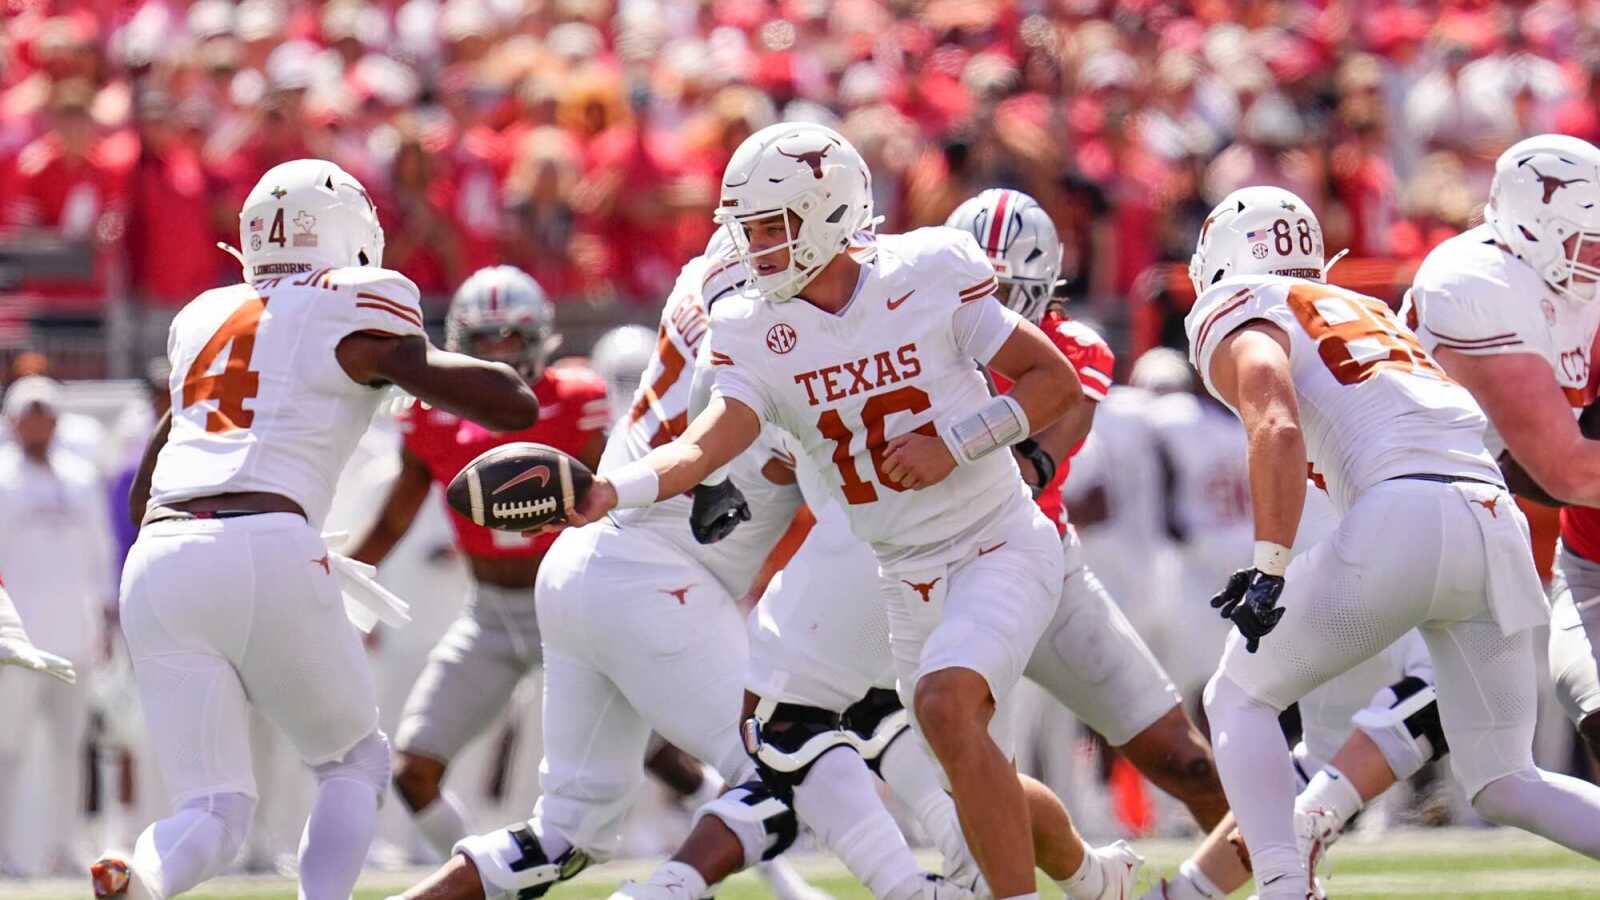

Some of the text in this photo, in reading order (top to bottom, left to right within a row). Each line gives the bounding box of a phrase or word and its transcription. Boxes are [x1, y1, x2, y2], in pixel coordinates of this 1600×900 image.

[268, 208, 287, 248] 4
[1273, 218, 1312, 256] 88
[253, 263, 312, 276] LONGHORNS
[767, 324, 796, 354] SEC
[182, 296, 270, 433] 4
[794, 343, 922, 405] TEXAS
[817, 385, 938, 504] 16
